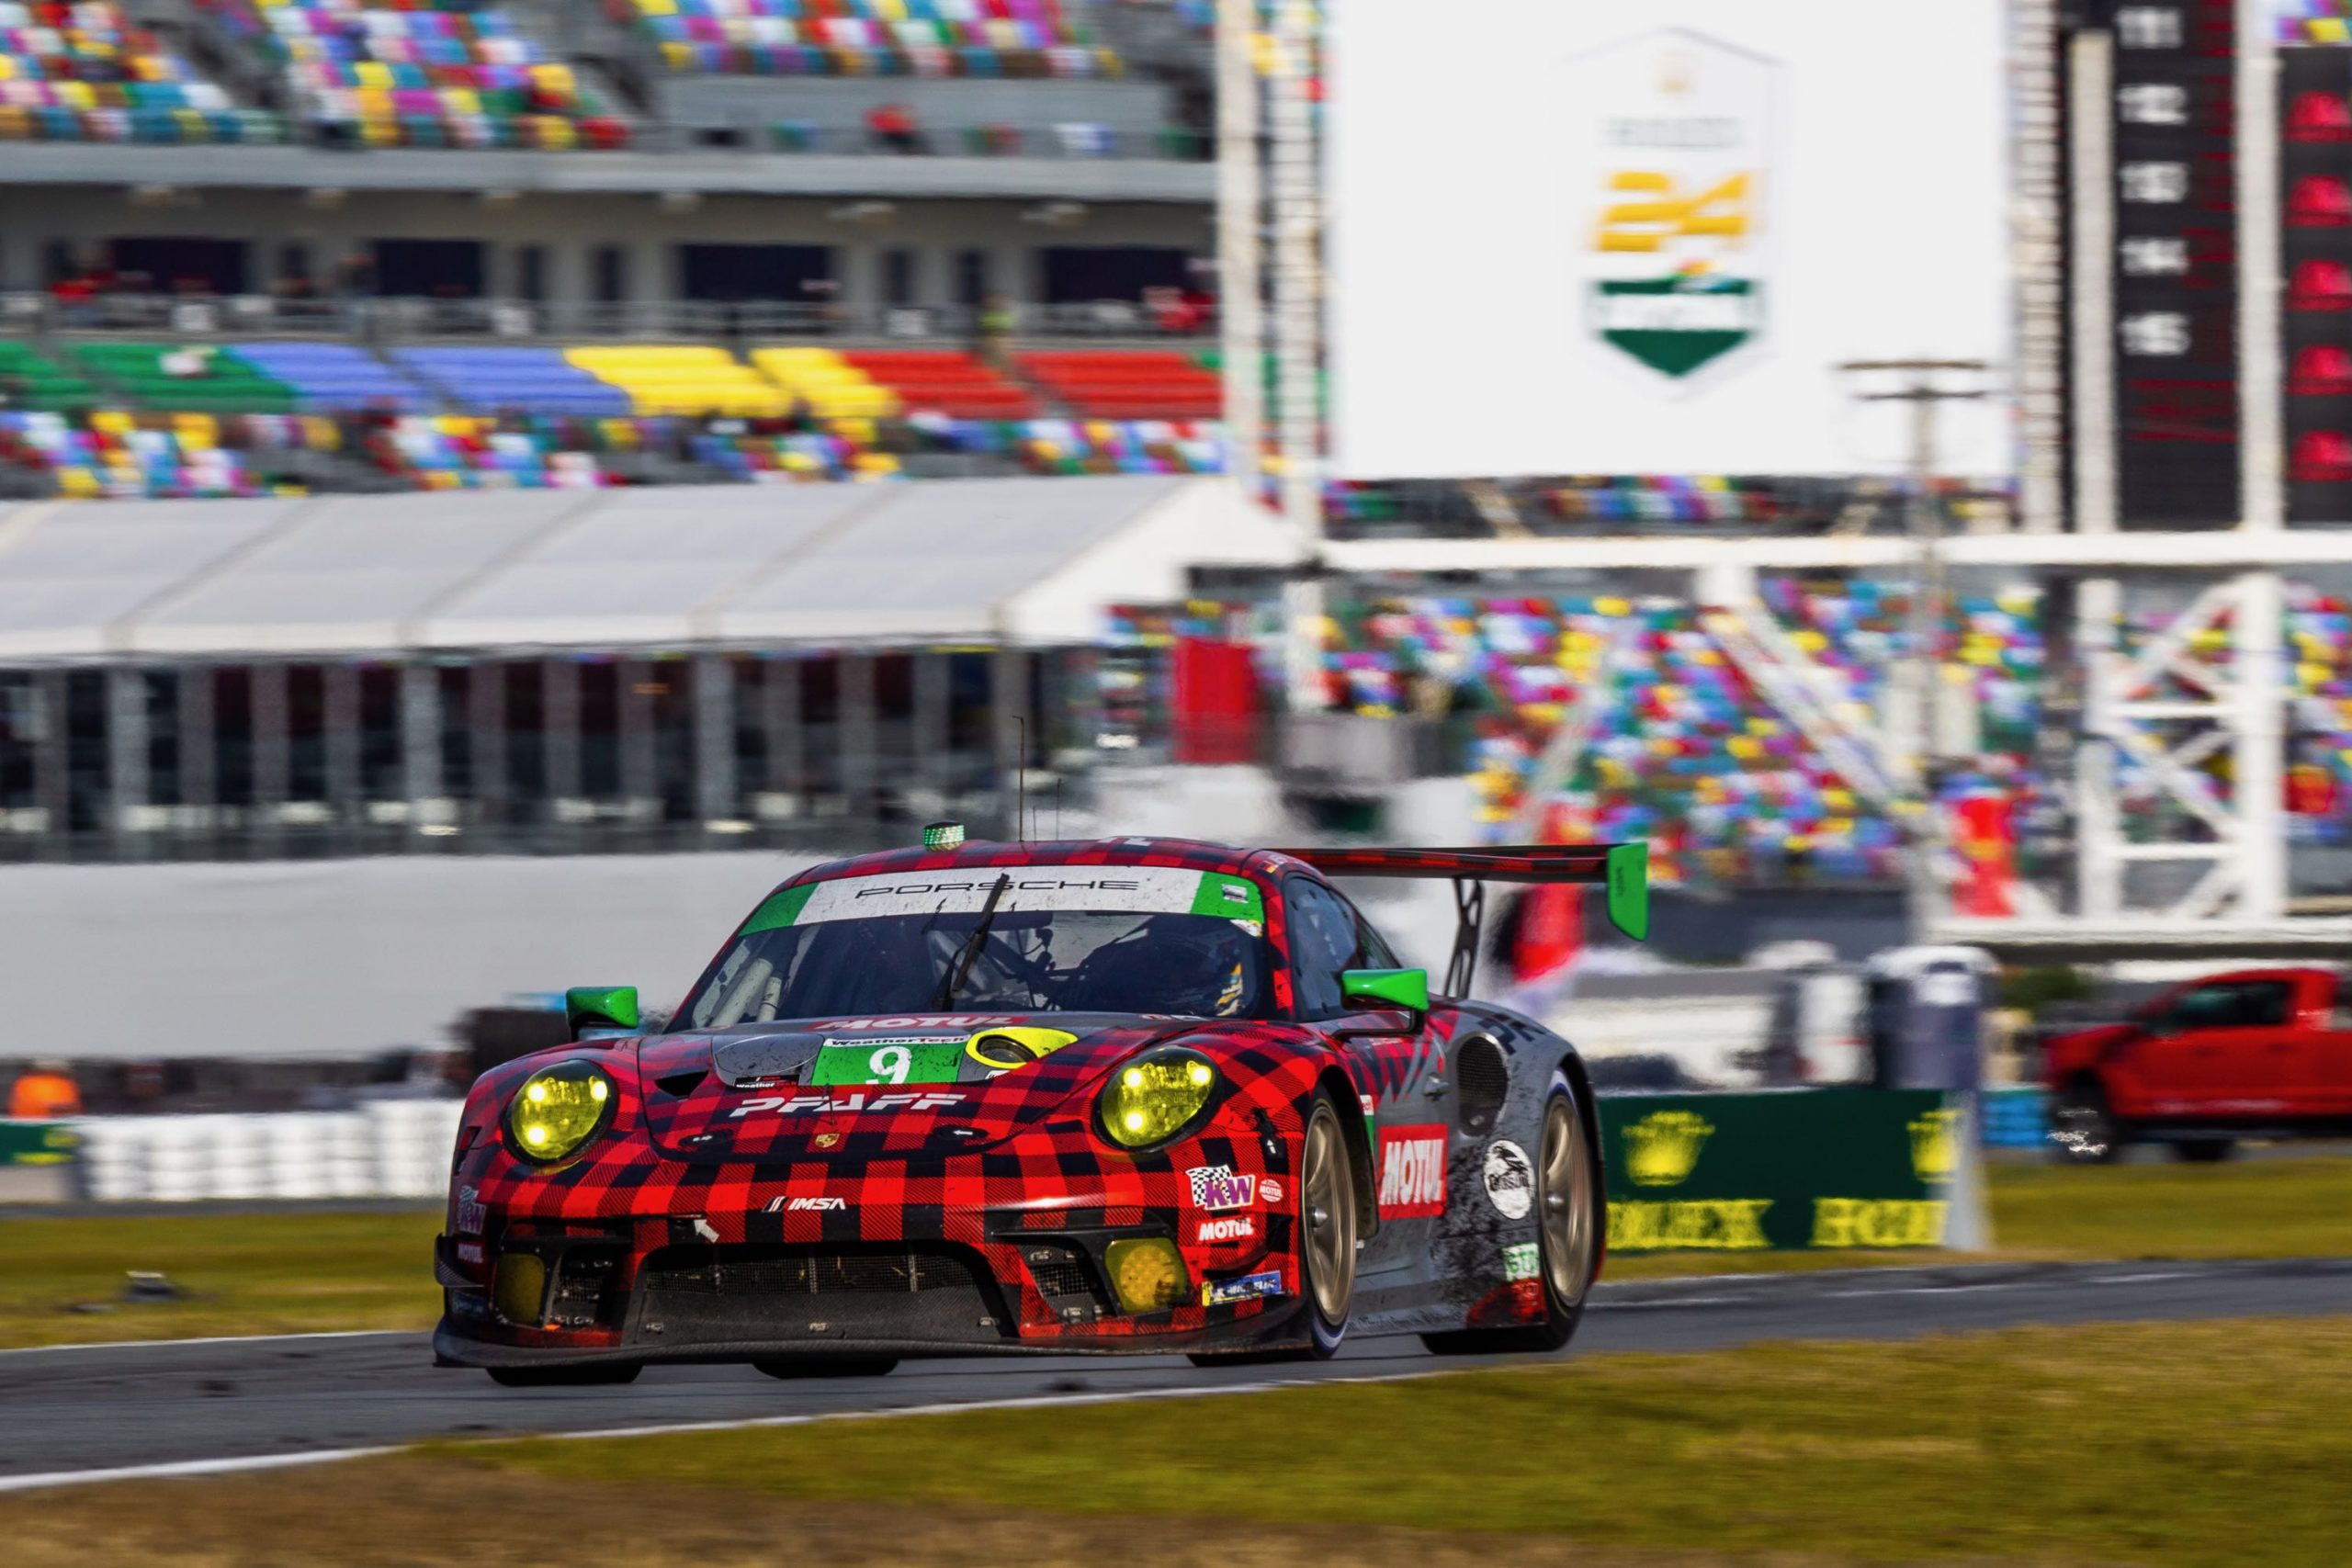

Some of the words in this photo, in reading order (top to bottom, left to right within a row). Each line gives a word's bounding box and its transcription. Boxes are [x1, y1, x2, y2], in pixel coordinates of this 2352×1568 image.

[854, 880, 1138, 899] PORSCHE
[815, 1016, 1012, 1030] MOTUL
[831, 1035, 965, 1046] WeatherTech
[865, 1045, 911, 1085] 9
[729, 1093, 967, 1118] PFAFF
[1379, 1139, 1443, 1205] MOTUL
[787, 1197, 846, 1211] IMSA
[1204, 1176, 1253, 1209] KW
[1199, 1217, 1254, 1241] MOTUL
